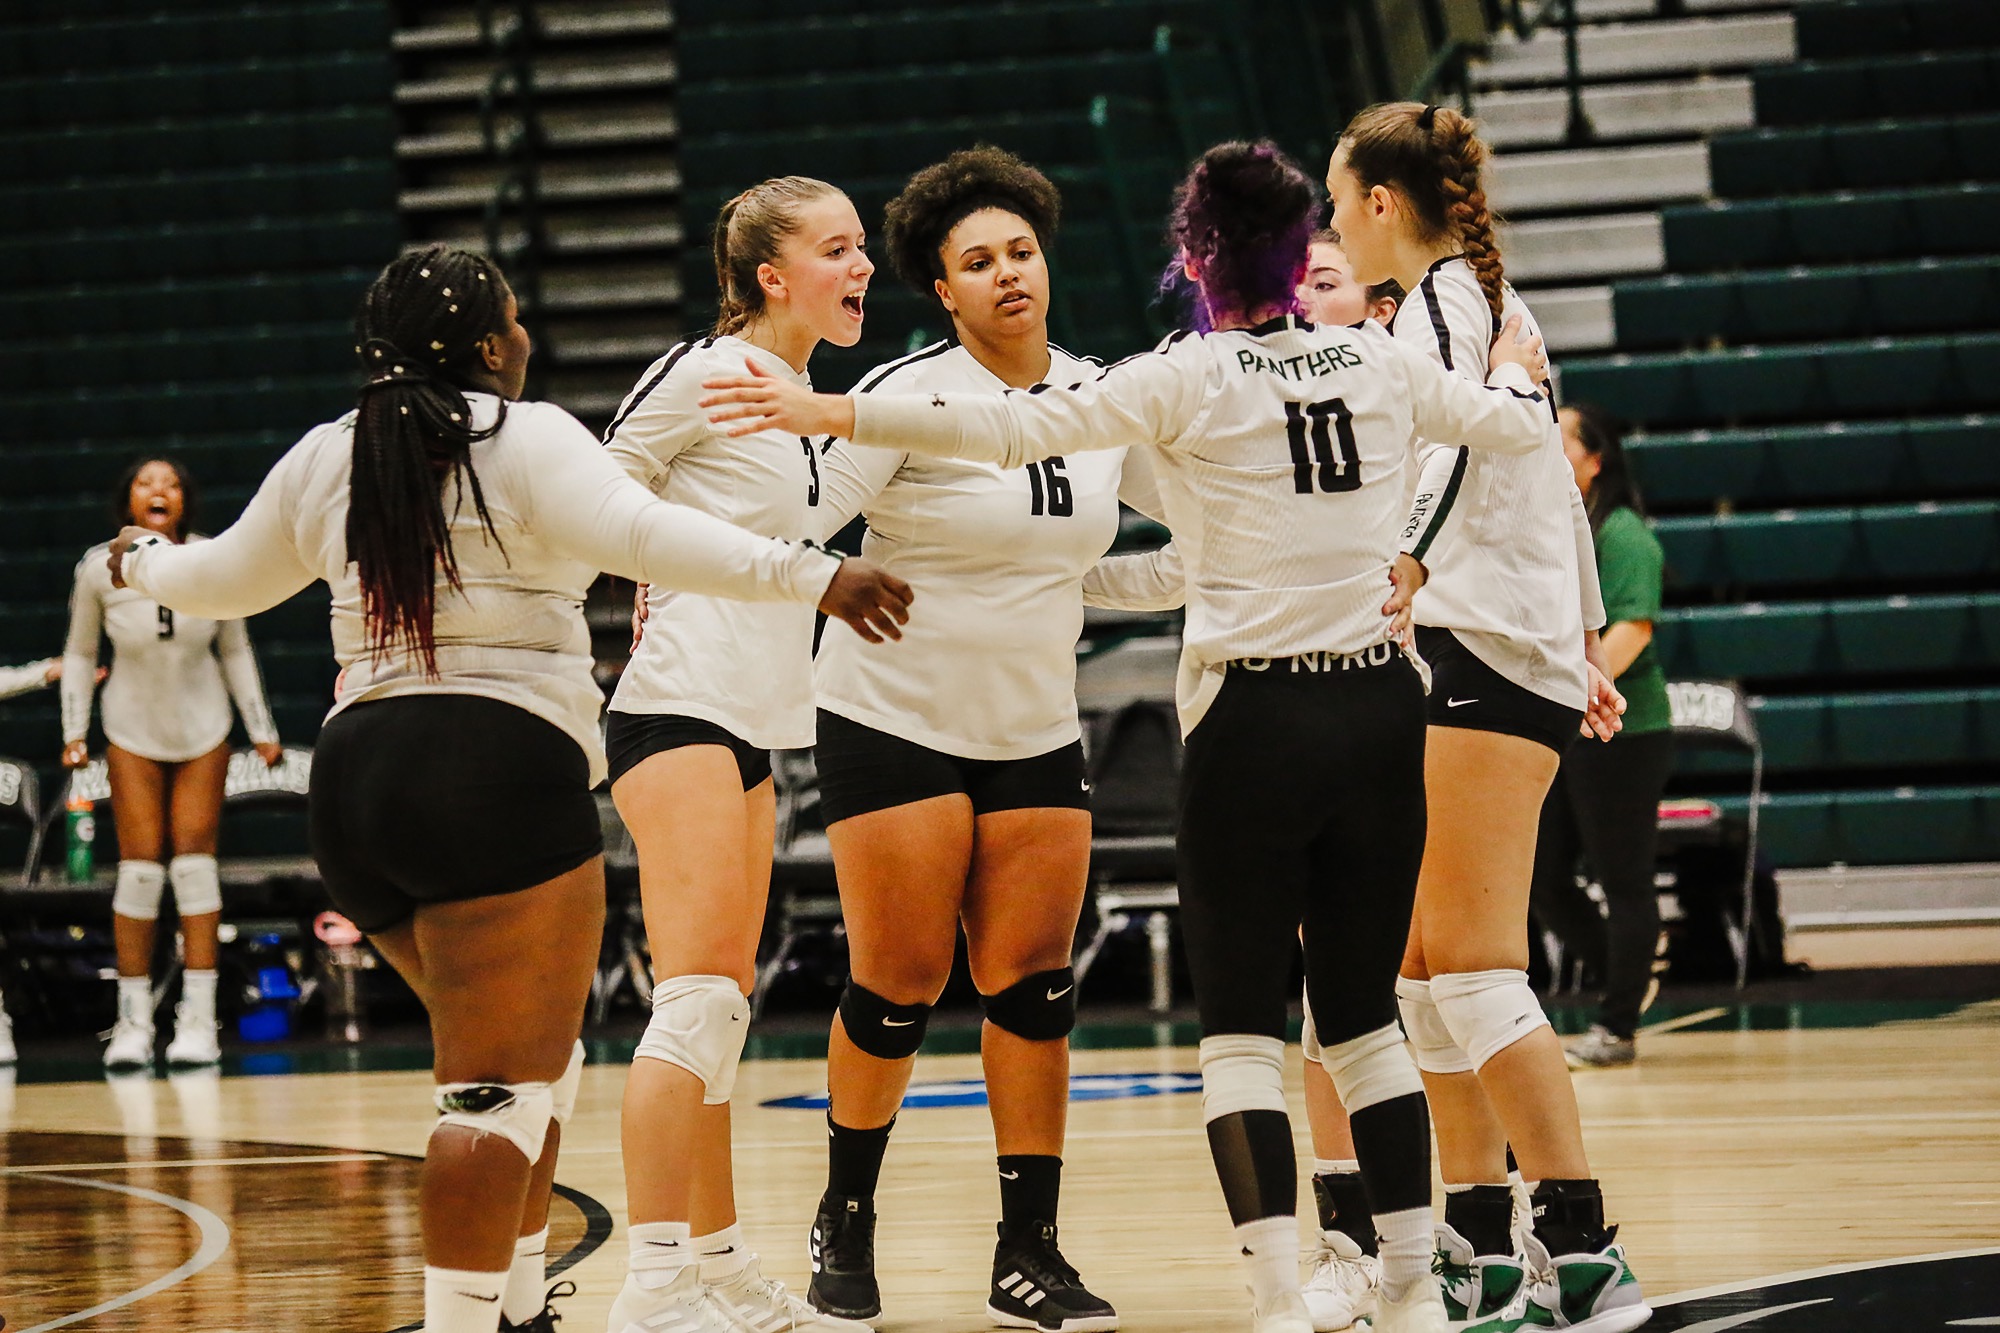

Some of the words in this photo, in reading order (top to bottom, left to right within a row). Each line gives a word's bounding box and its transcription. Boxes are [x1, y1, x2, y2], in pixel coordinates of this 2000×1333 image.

[800, 436, 820, 507] 3
[1284, 397, 1363, 494] 10
[1025, 455, 1073, 517] 16
[157, 605, 174, 641] 9
